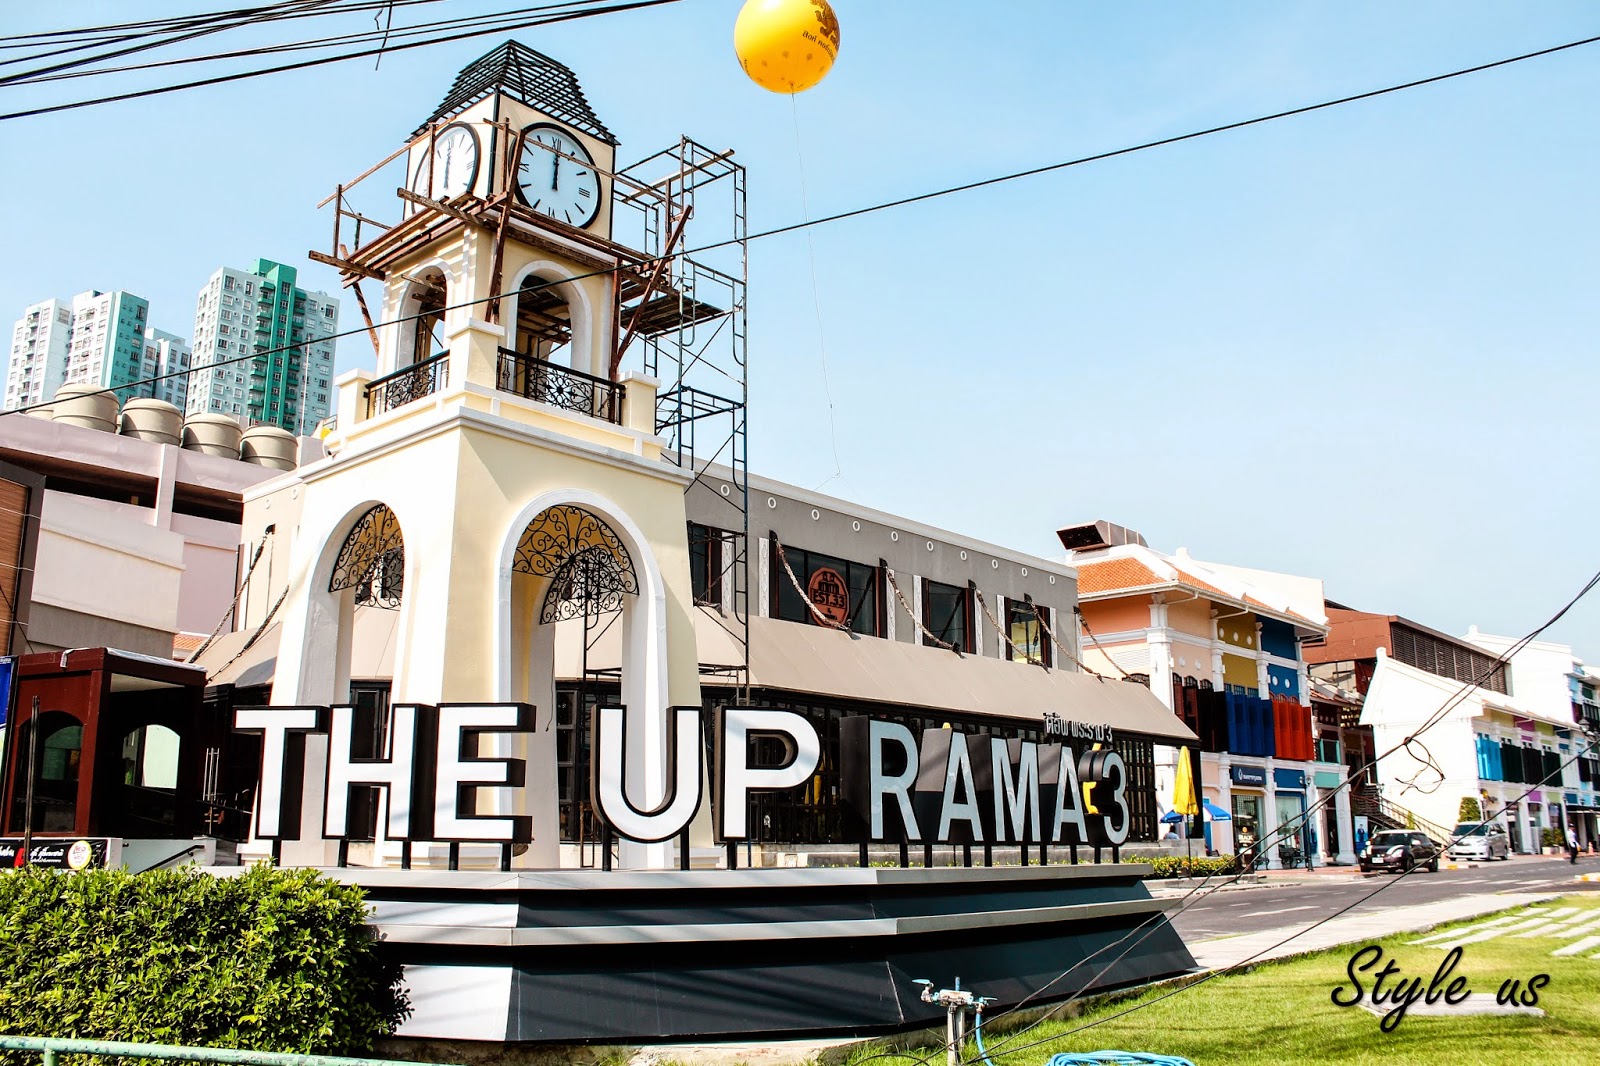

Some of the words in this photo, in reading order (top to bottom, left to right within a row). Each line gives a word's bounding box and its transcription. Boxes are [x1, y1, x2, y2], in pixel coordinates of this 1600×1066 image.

[1105, 724, 1113, 742] 3
[233, 703, 530, 843] THE
[592, 704, 822, 843] UP
[866, 718, 1089, 843] RAMA
[1093, 750, 1130, 846] 3
